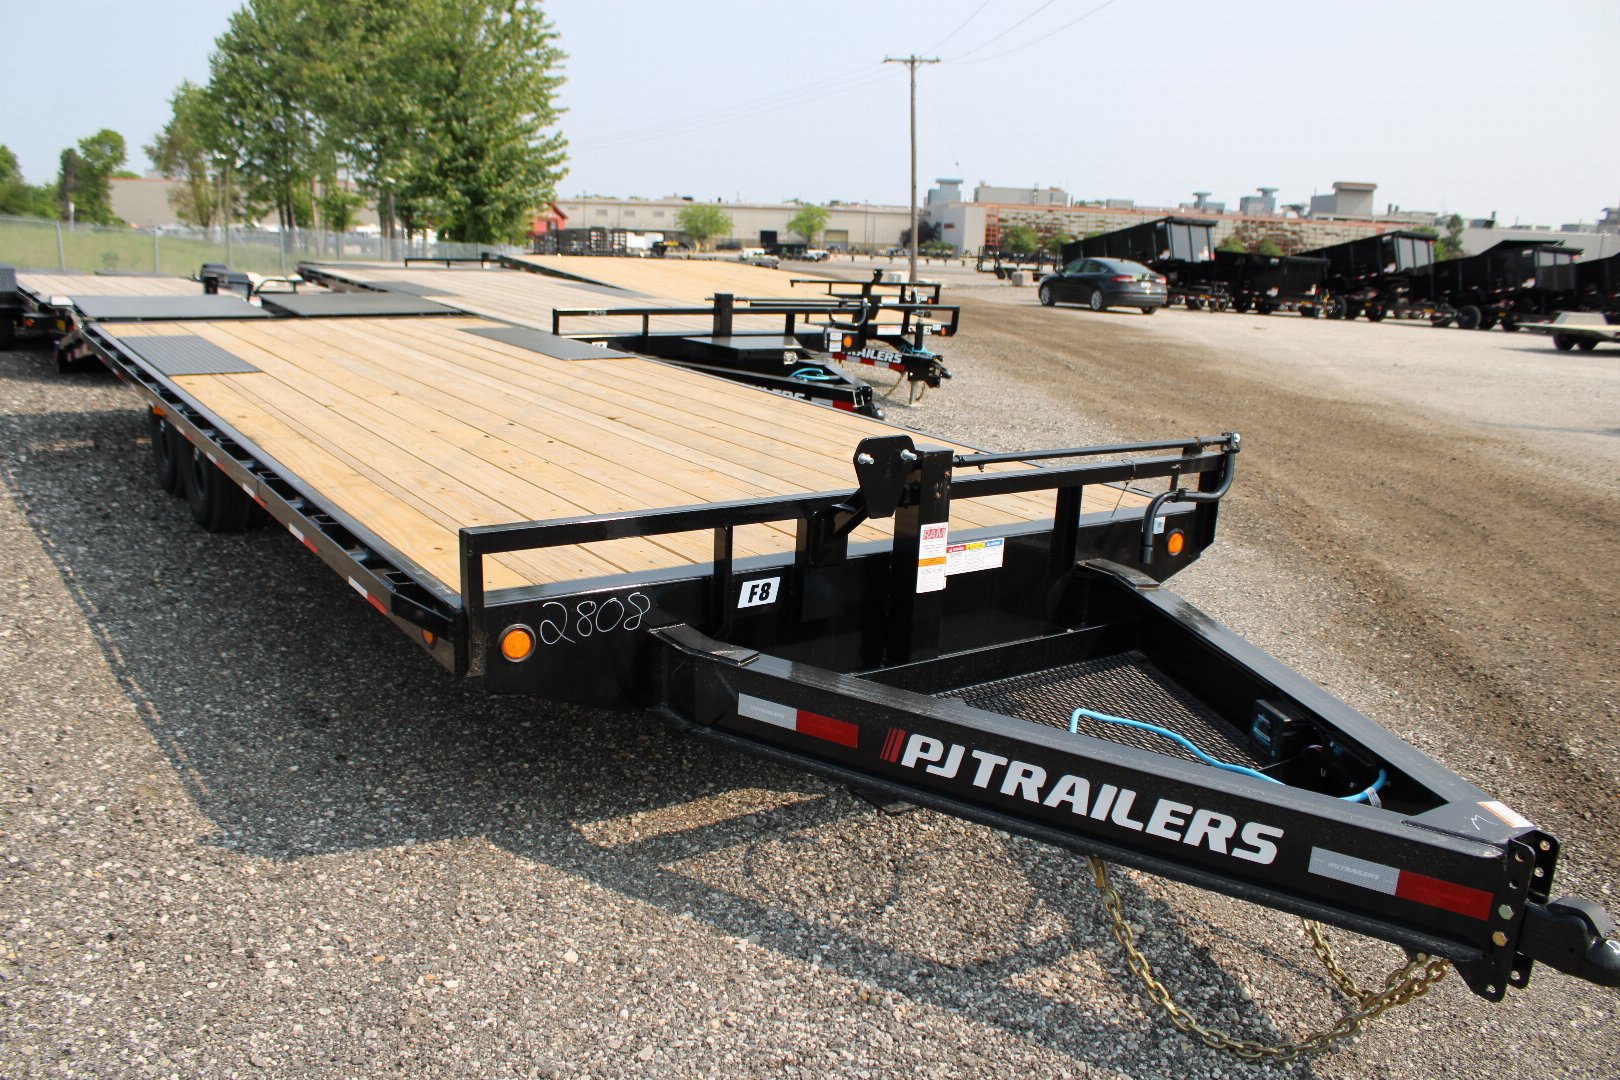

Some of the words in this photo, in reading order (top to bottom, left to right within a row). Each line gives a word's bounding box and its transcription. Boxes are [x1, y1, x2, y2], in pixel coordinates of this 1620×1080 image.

[540, 592, 650, 644] 2808
[748, 582, 771, 603] F8
[901, 734, 965, 779] PJ
[972, 750, 1285, 865] TRAILERS
